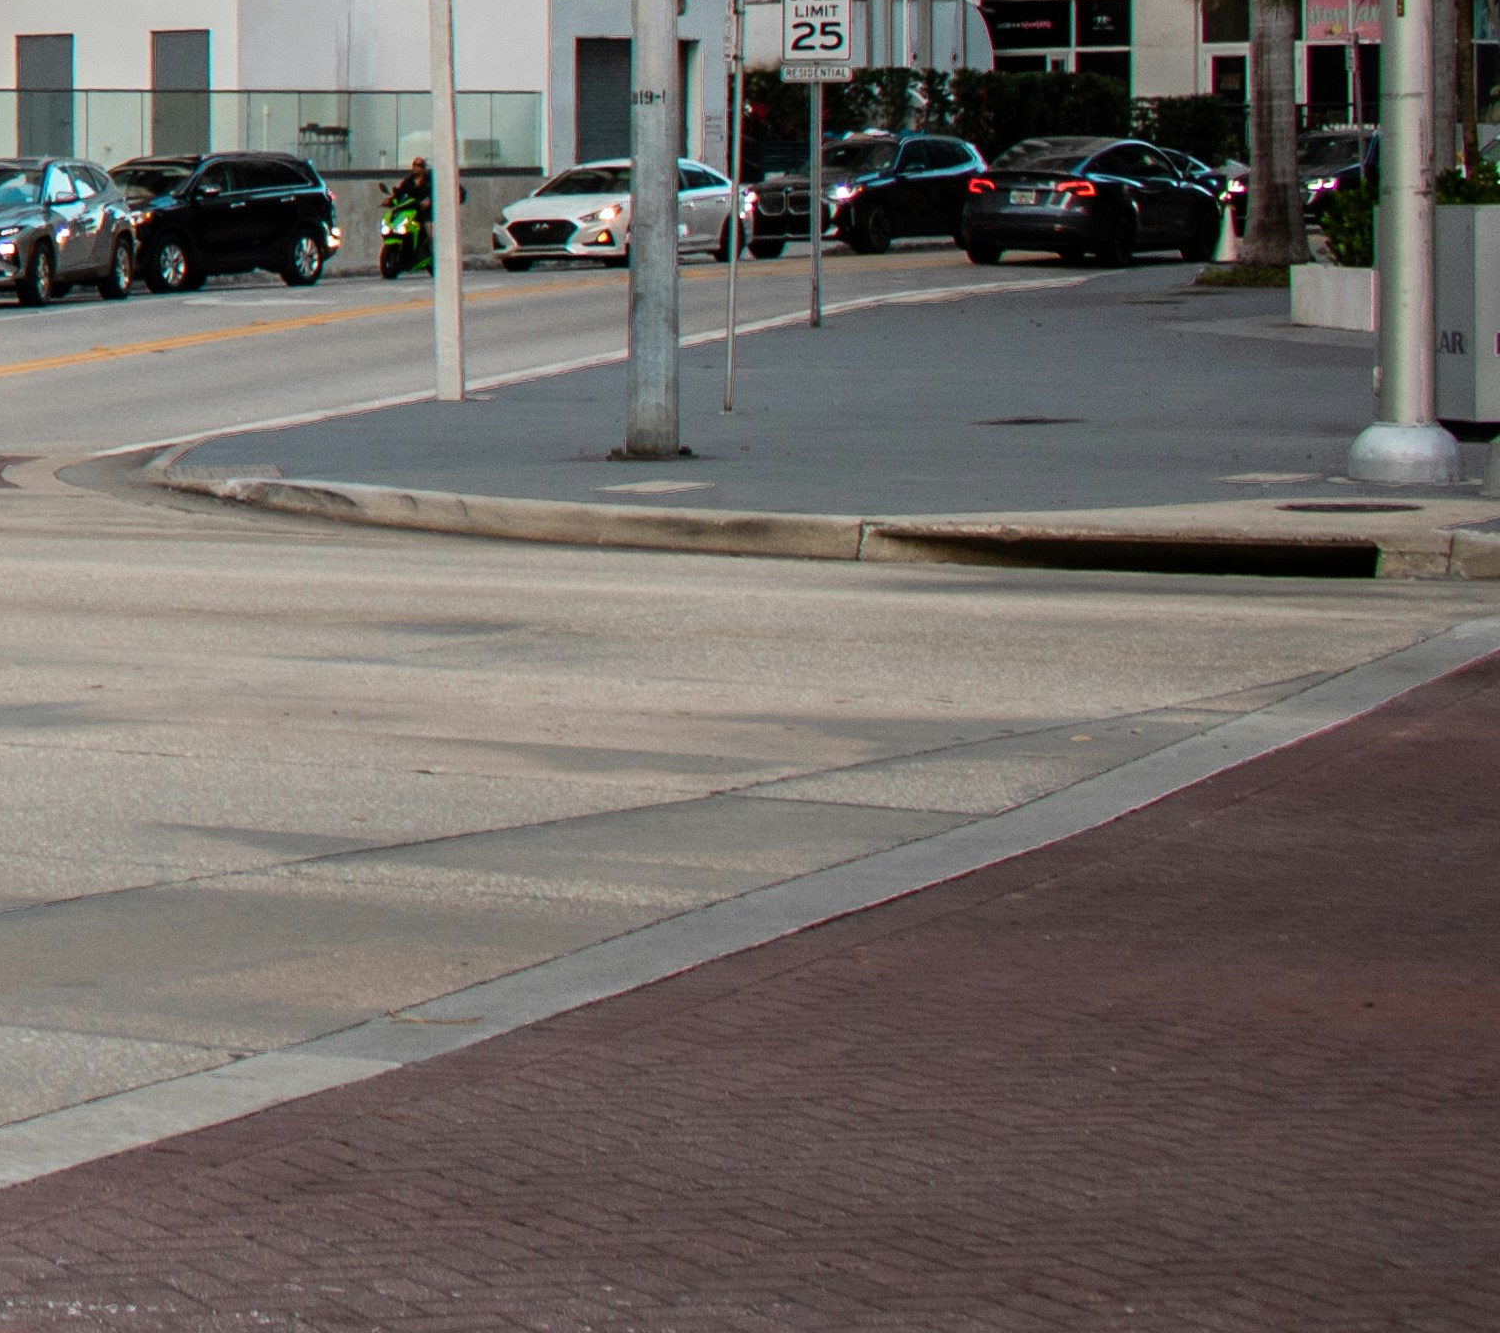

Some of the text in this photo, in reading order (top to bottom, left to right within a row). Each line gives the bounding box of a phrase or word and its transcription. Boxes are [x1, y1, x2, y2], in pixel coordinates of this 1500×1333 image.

[794, 4, 839, 18] LIMIT
[791, 21, 845, 51] 25
[785, 67, 848, 79] RESIDENTIAL
